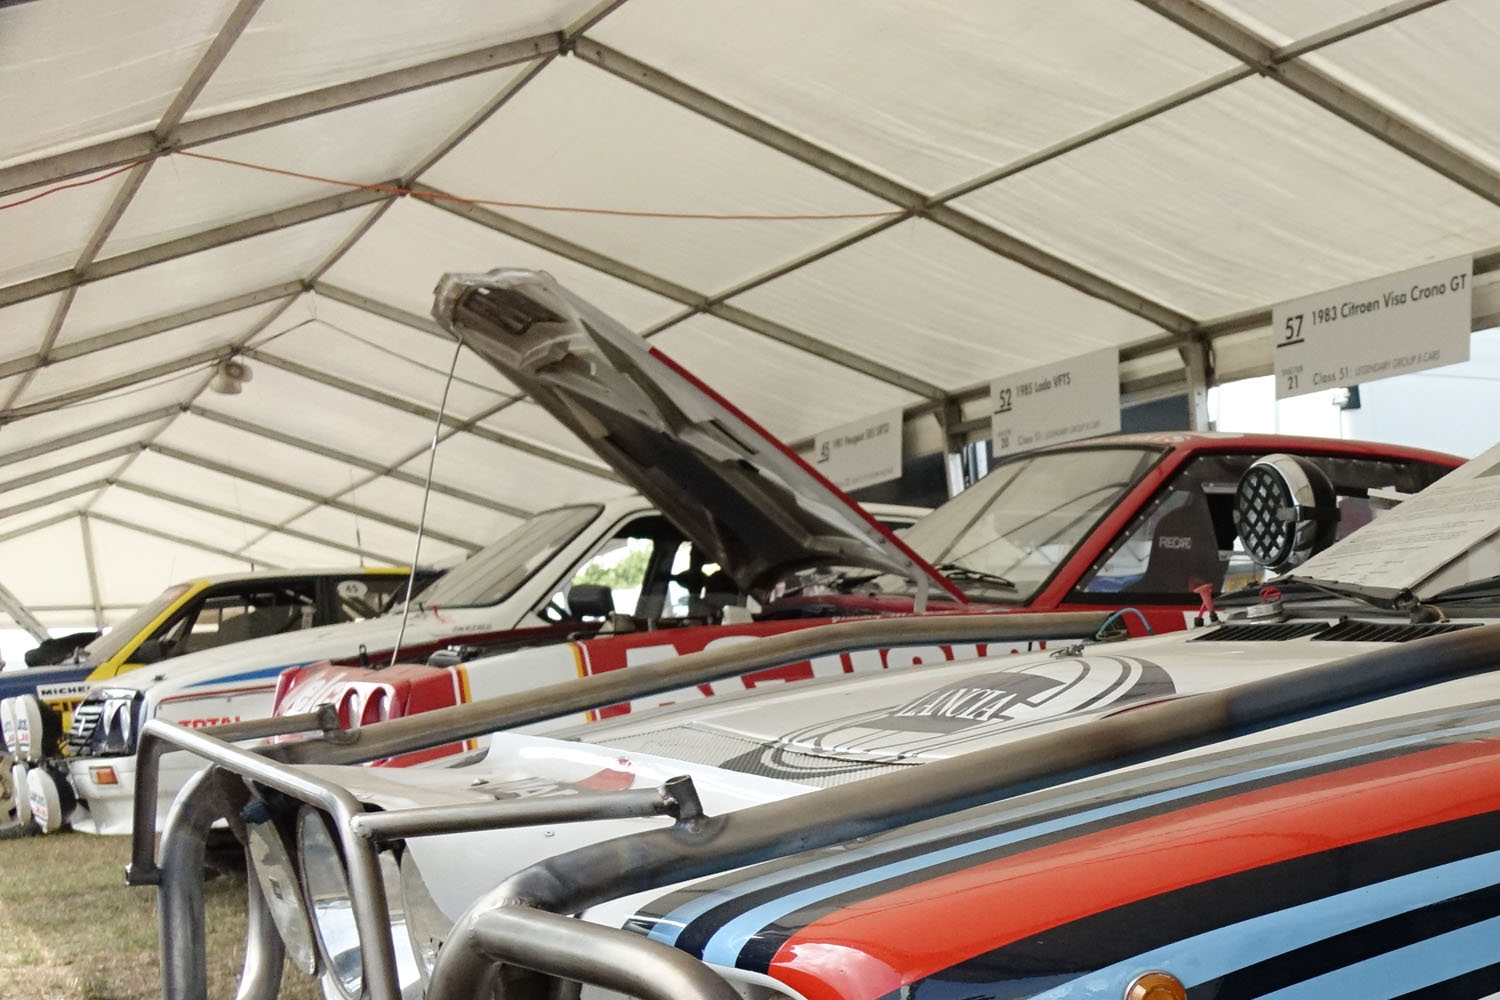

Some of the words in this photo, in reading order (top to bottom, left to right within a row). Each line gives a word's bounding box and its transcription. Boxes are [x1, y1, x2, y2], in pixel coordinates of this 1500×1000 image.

[1311, 305, 1338, 326] 1983
[1382, 290, 1407, 310] Visa
[1410, 284, 1447, 303] Crono
[1449, 273, 1468, 293] GT
[1284, 313, 1305, 341] 57
[40, 685, 91, 697] MICHE
[894, 687, 1018, 721] LANCIA
